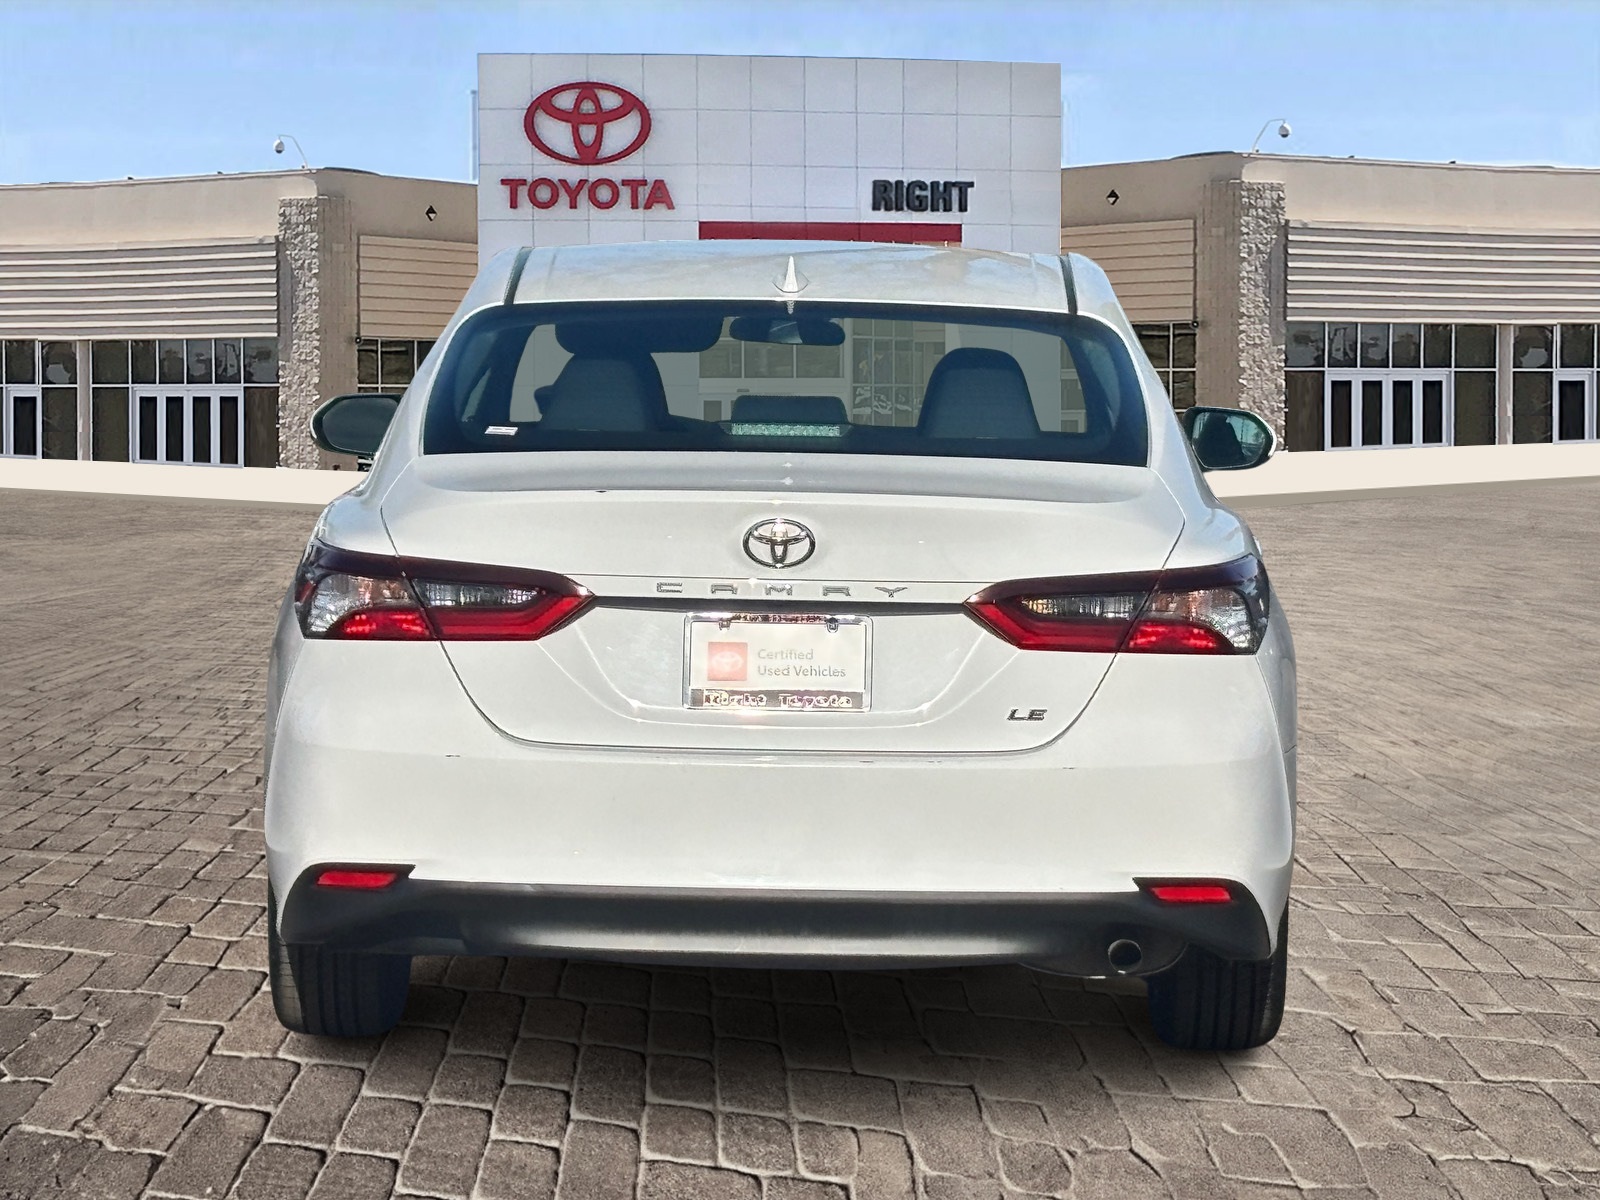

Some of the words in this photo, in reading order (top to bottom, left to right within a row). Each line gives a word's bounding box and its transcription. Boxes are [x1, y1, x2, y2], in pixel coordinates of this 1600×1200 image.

[500, 178, 675, 210] TOYOTA
[872, 180, 975, 213] RIGHT
[656, 581, 908, 598] CAMRY
[757, 648, 815, 661] Certified
[757, 665, 790, 677] Used
[793, 665, 847, 678] Vehicles
[1006, 708, 1048, 721] LE
